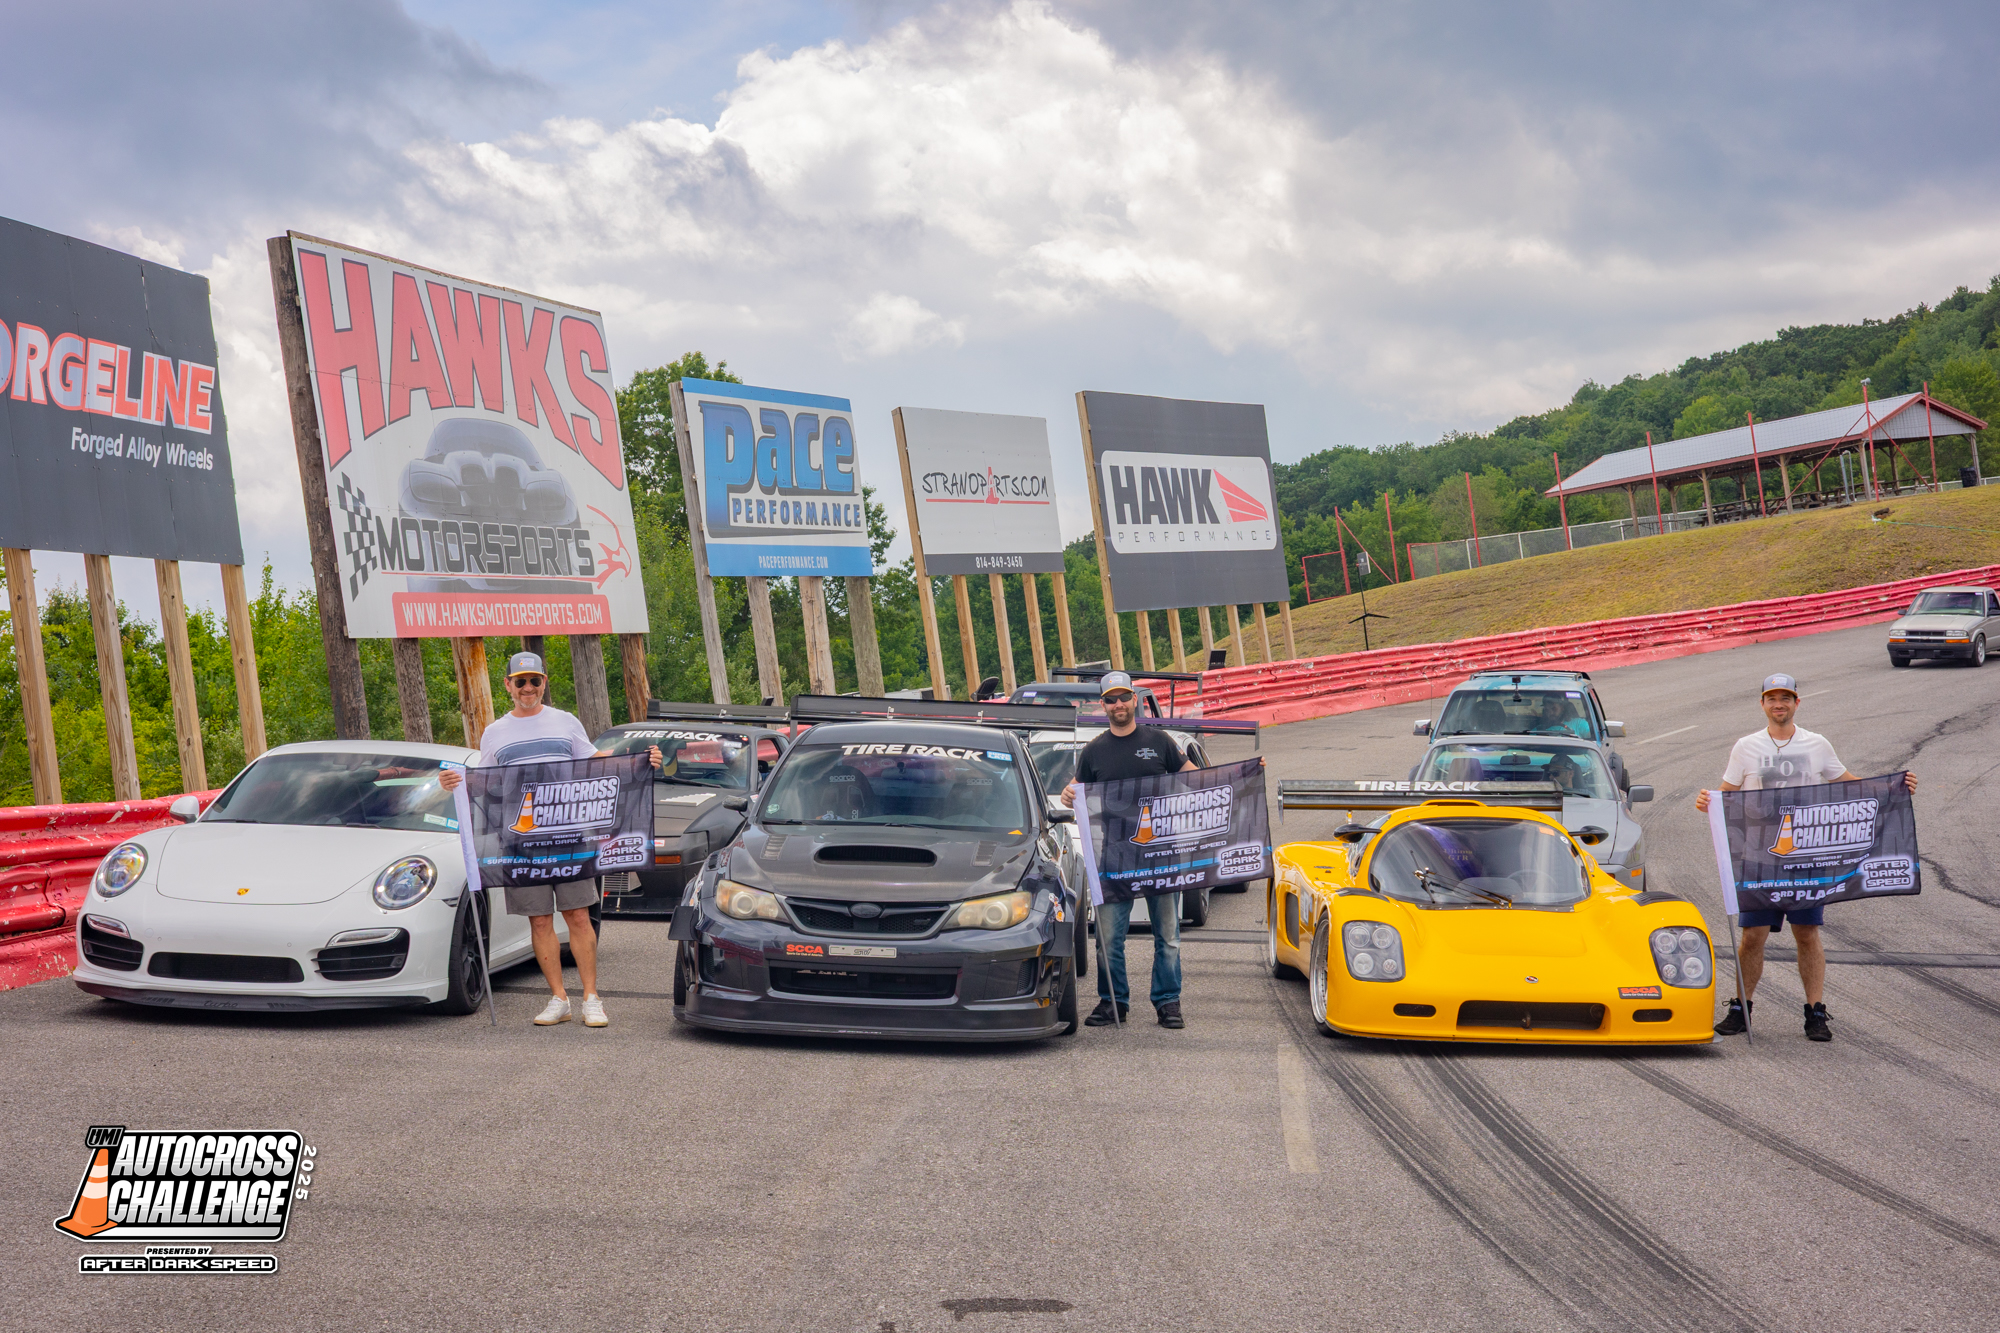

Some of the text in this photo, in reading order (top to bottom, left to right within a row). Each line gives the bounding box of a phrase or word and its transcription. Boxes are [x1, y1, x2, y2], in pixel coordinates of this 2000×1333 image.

[297, 247, 625, 491] HAWKS
[71, 427, 214, 471] Forged Alloy Wheels
[922, 467, 1049, 503] STRANOPARTS.COM
[1109, 465, 1221, 525] HAWK
[732, 498, 861, 527] PERFORMANCE
[1118, 530, 1272, 543] PERFORMANCE
[375, 515, 595, 576] MOTORSPORTS
[758, 555, 828, 569] PACEPERFORMANCE.COM
[975, 556, 1023, 568] 814-849-3450
[401, 602, 603, 626] WWW.HAWKSMOTORSPORTS.COM
[623, 731, 723, 742] TIRE RACK
[841, 744, 983, 762] TIRE RACK
[533, 778, 618, 806] AUTOCROSS
[1355, 781, 1481, 792] TIRE RACK
[1151, 787, 1231, 817] AUTOCROSS
[533, 799, 615, 826] CHALLENGE
[1793, 800, 1876, 827] AUTOCROSS
[1152, 806, 1229, 836] CHALLENGE
[582, 834, 611, 842] SPEED
[1792, 821, 1873, 848] CHALLENGE
[602, 837, 643, 851] AFTER
[1144, 841, 1227, 858] AFTER DARK SPEED
[600, 854, 643, 865] SPEED
[602, 846, 643, 859] DARK
[1221, 846, 1260, 859] AFTER
[1843, 853, 1870, 865] SPEED
[532, 857, 558, 865] CLASS
[1222, 854, 1259, 866] DARK
[1864, 860, 1909, 870] AFTER
[511, 865, 582, 879] 1ST PLACE
[1110, 872, 1138, 880] SUPER
[1154, 866, 1178, 875] CLASS
[1221, 862, 1261, 875] SPEED
[1869, 868, 1907, 878] DARK
[1131, 872, 1206, 892] 2ND PLACE
[1774, 880, 1793, 888] LATE
[1866, 877, 1910, 888] SPEED
[1770, 883, 1846, 902] 3RD PLACE
[786, 944, 824, 954] SCCA
